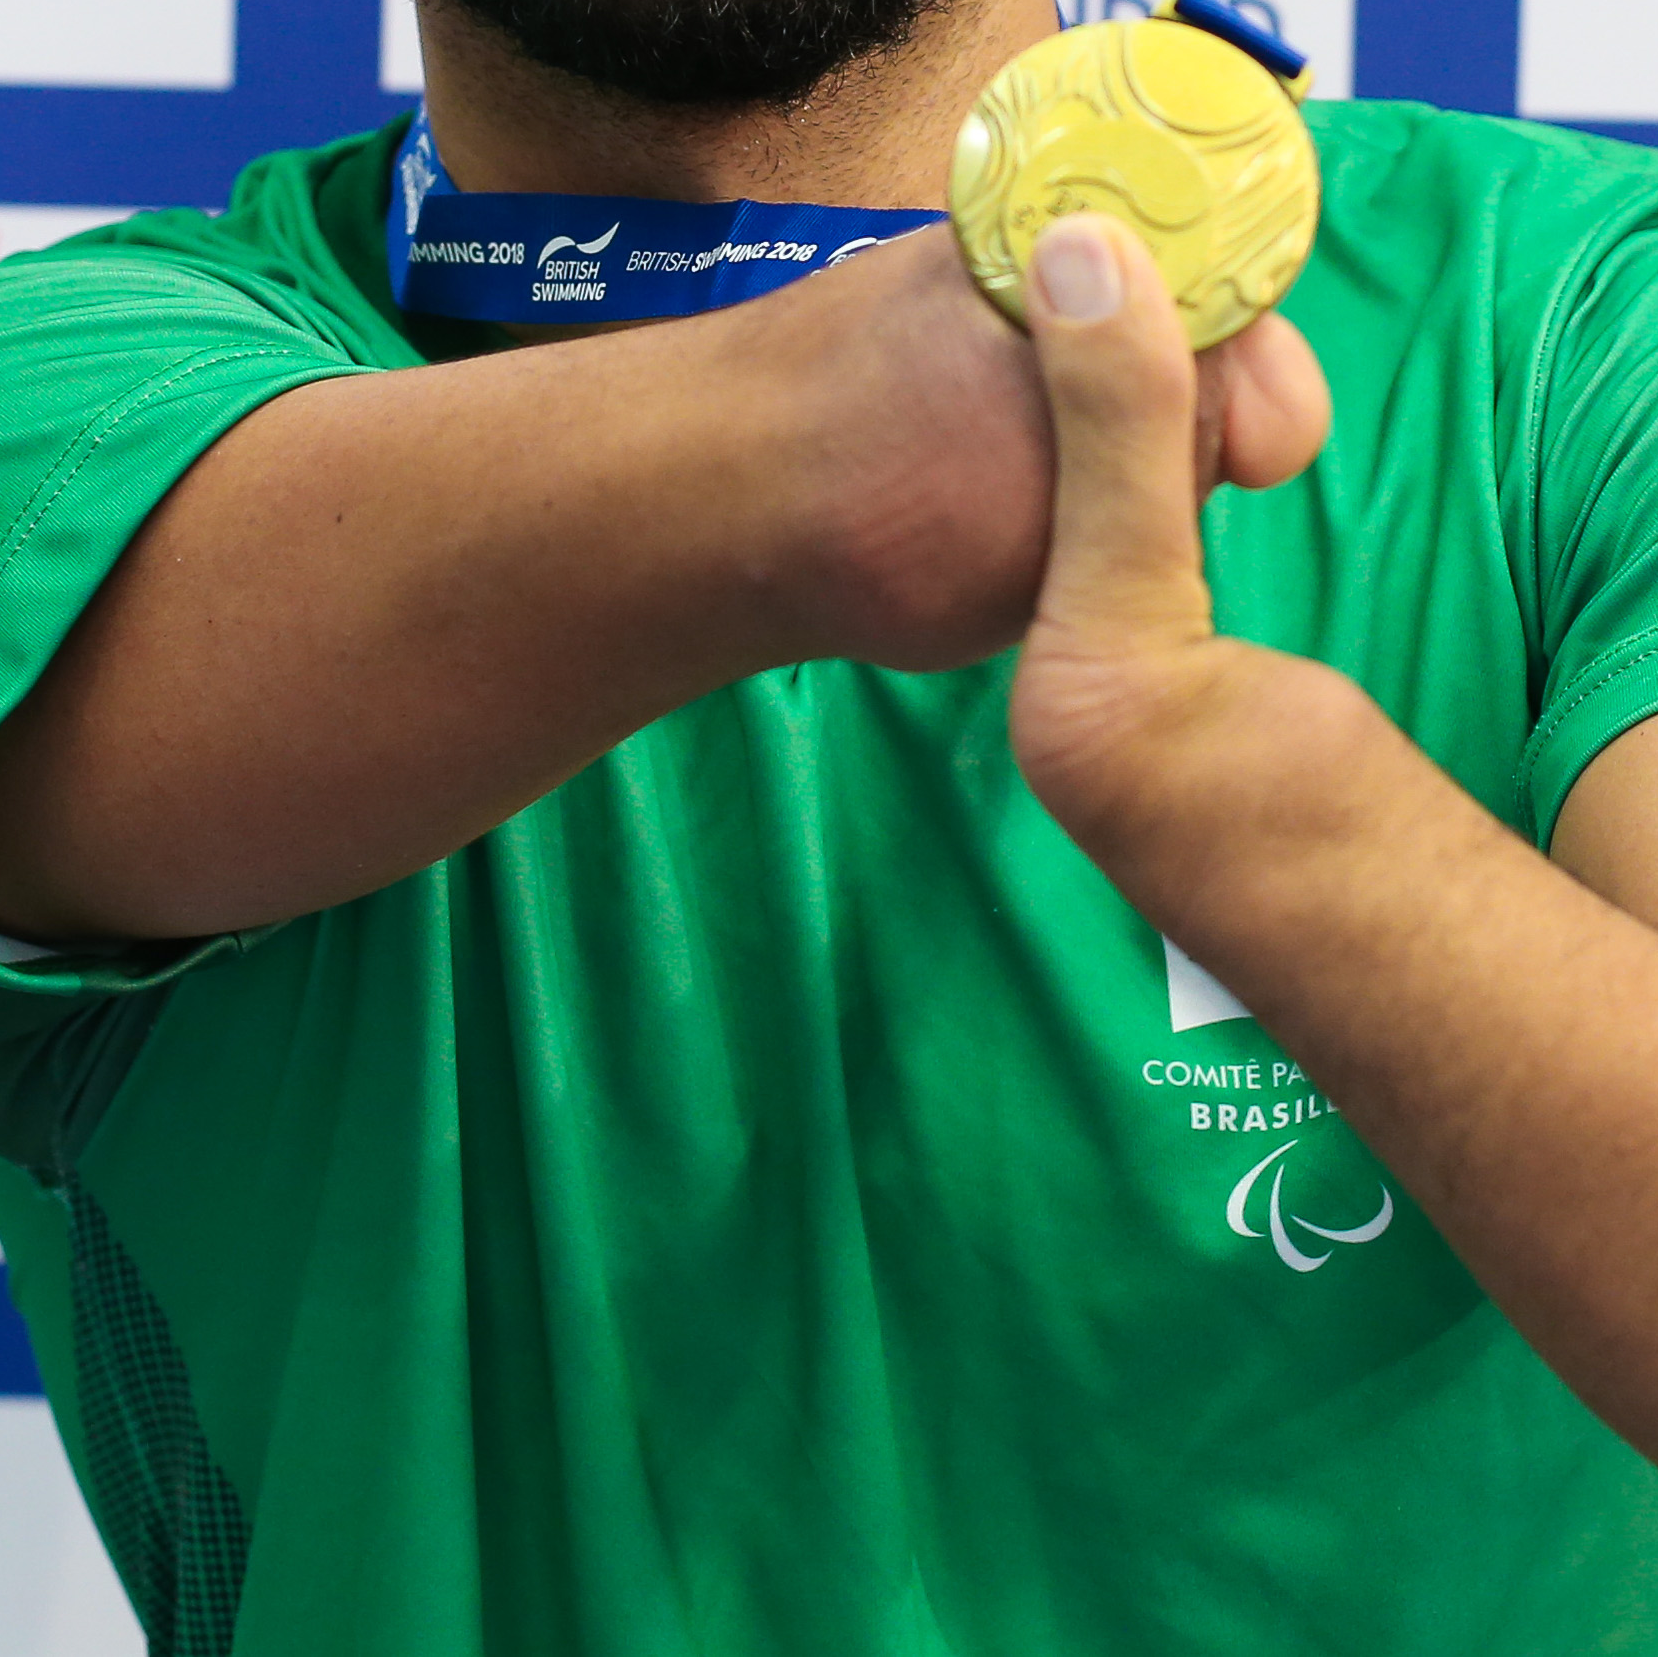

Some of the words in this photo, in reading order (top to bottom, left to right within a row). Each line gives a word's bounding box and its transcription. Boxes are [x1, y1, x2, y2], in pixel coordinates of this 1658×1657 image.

[487, 242, 524, 265] 2018
[626, 250, 693, 273] BRITISH
[765, 241, 818, 262] 2018
[545, 260, 600, 280] BRITISH
[532, 282, 607, 302] SWIMMING
[1143, 1058, 1262, 1090] COMITÊ
